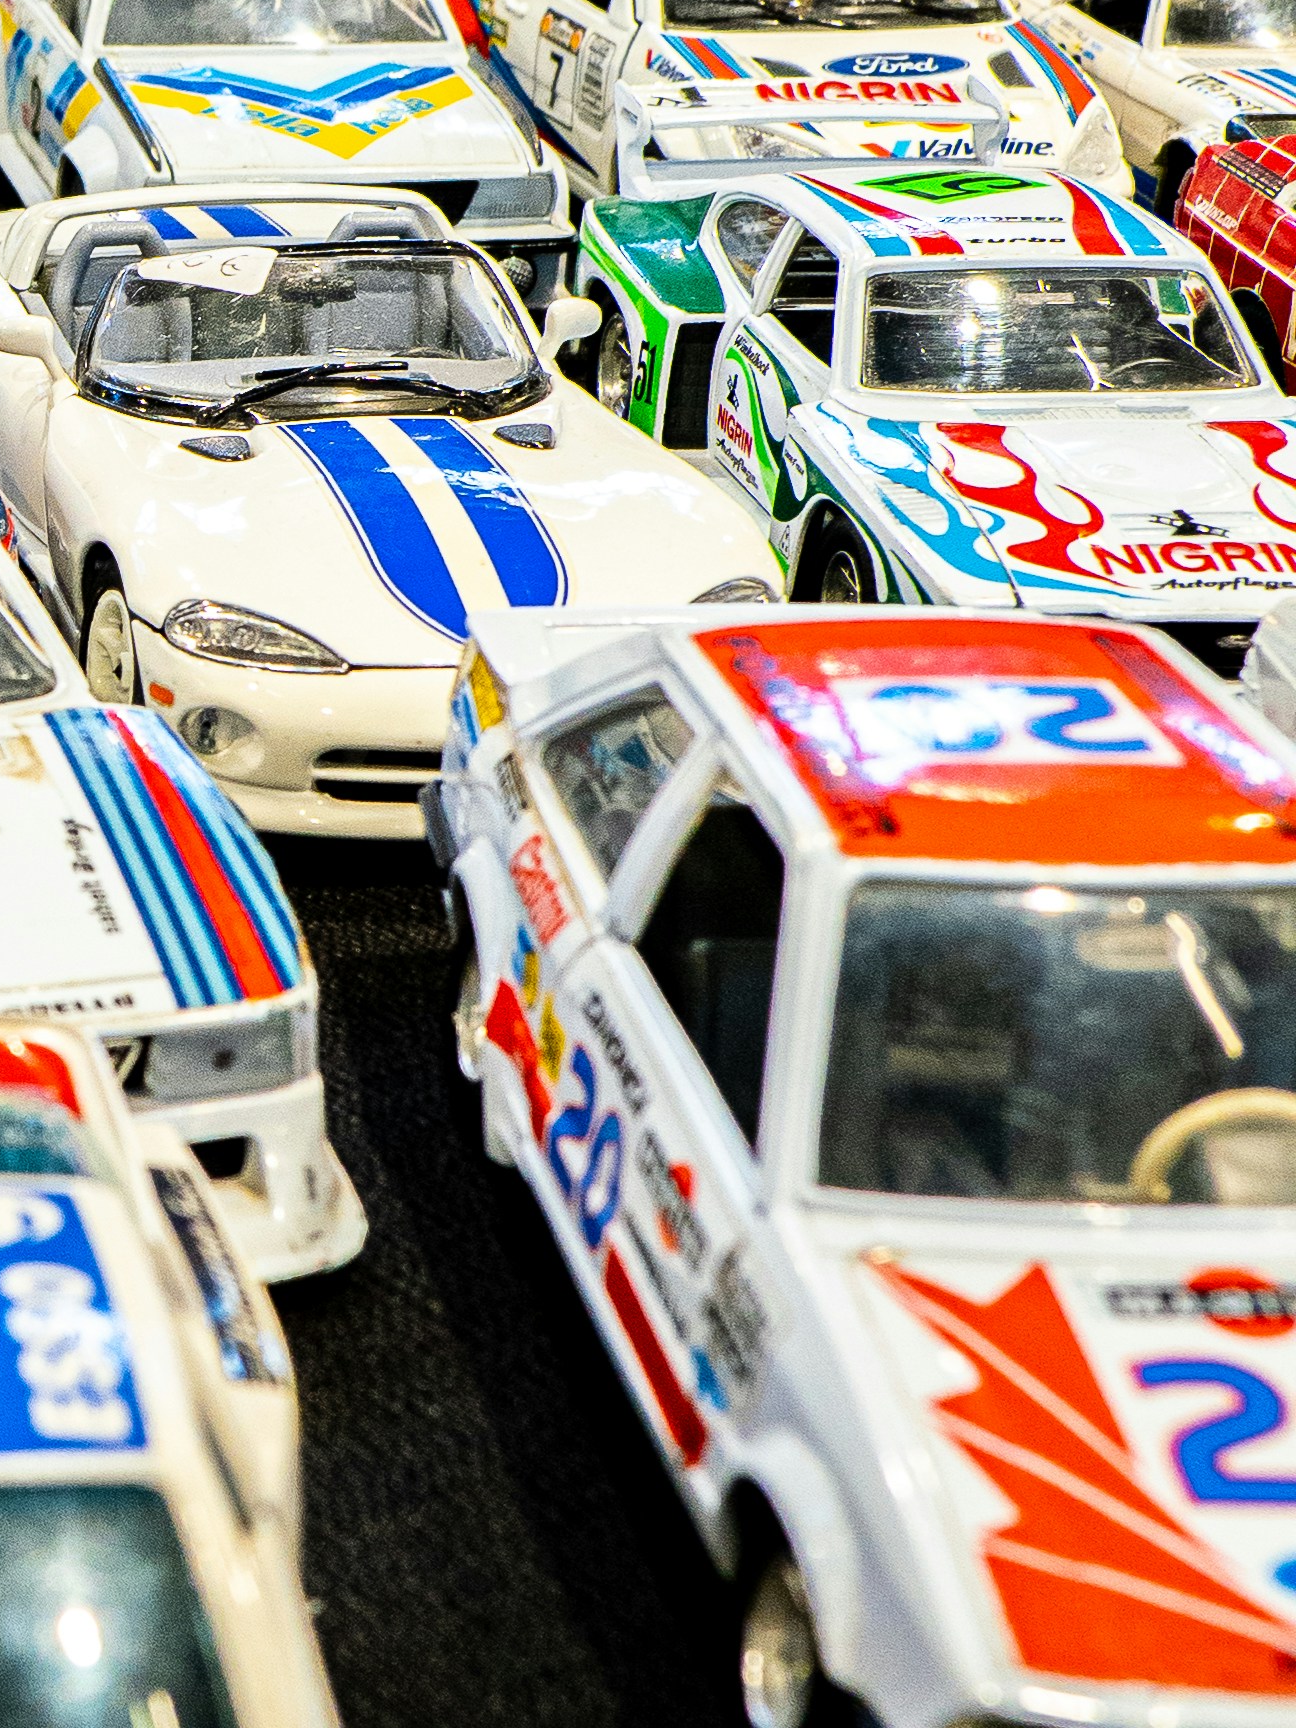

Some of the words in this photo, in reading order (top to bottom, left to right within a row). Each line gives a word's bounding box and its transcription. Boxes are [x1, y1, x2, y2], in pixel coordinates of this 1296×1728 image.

[853, 55, 939, 74] Ford
[755, 80, 962, 104] NIGRIN
[1195, 194, 1238, 230] DUNLOP
[966, 236, 1067, 245] turbo
[633, 339, 657, 405] 51
[717, 403, 754, 459] NIGRIN
[1151, 577, 1295, 591] Autopflege
